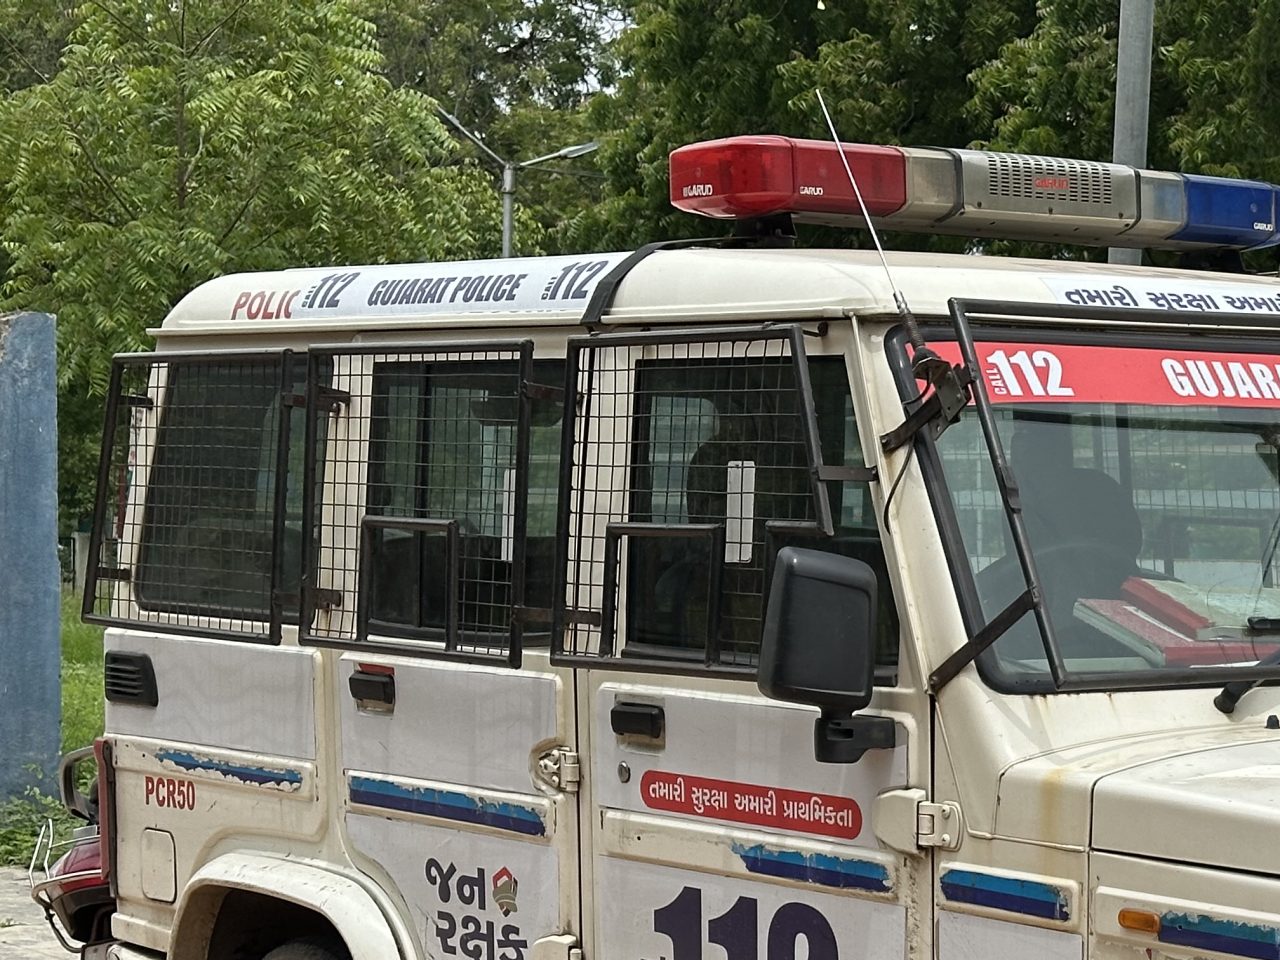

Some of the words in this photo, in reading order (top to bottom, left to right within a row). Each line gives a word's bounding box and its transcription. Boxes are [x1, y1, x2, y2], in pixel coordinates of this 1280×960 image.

[308, 271, 361, 309] 112
[367, 276, 458, 306] GUJARAT
[449, 273, 528, 303] POLICE
[548, 260, 609, 300] 112
[1065, 285, 1139, 307] તમારી
[986, 350, 1075, 396] 112
[986, 367, 1007, 395] CALL
[145, 776, 195, 811] PCR50
[649, 777, 685, 803] તમારી
[691, 786, 728, 813] સુરક્ષા
[734, 791, 777, 816] અમારી
[783, 797, 853, 828] પ્રાથમિકતા
[425, 857, 486, 911] જન
